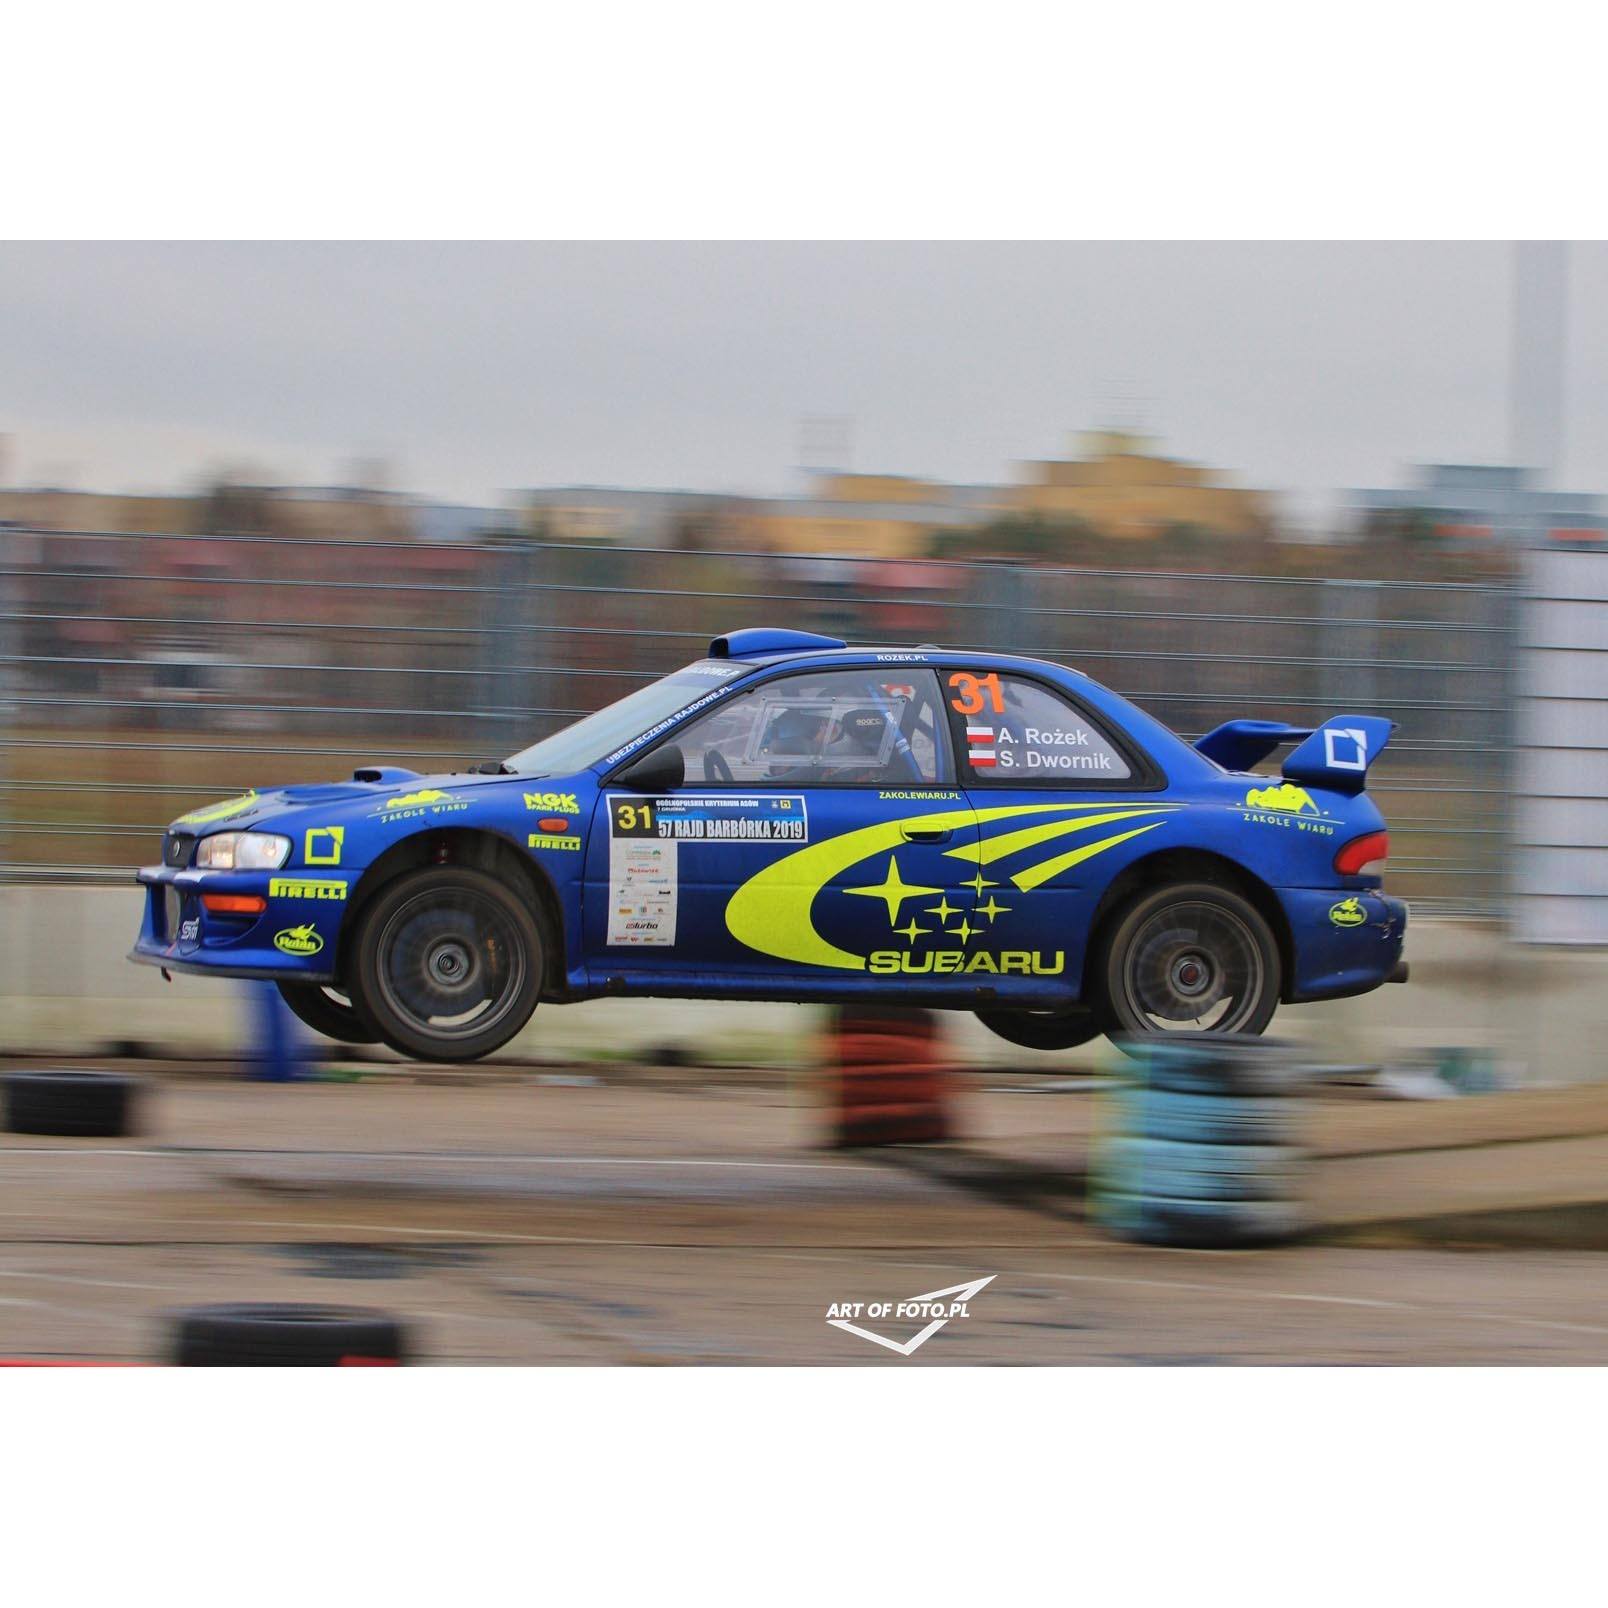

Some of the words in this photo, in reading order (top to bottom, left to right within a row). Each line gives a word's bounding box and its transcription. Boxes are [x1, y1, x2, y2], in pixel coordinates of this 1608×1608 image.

[948, 671, 1006, 715] 31
[606, 717, 676, 764] UBEZPIECZENIA
[674, 685, 733, 720] RAJDOWE.PL
[998, 727, 1019, 744] A.
[1025, 728, 1089, 745] Rożek
[1000, 751, 1020, 768] S.
[1027, 752, 1111, 770] Dwornik
[523, 793, 579, 809] NGK
[879, 791, 961, 800] ZAKOLEWIARU.PL
[381, 808, 425, 824] ZAKOLE
[432, 803, 468, 815] WIARU
[618, 805, 652, 829] 31
[1243, 813, 1290, 827] ZAKOLE
[1297, 821, 1334, 835] WIARU
[658, 820, 671, 838] 57
[674, 820, 704, 838] RAJD
[706, 817, 772, 839] BARBÓRKA
[773, 820, 802, 839] 2019
[528, 834, 581, 850] PIRELLI
[269, 877, 348, 900] PIRELLI
[868, 950, 1065, 975] SUBARU
